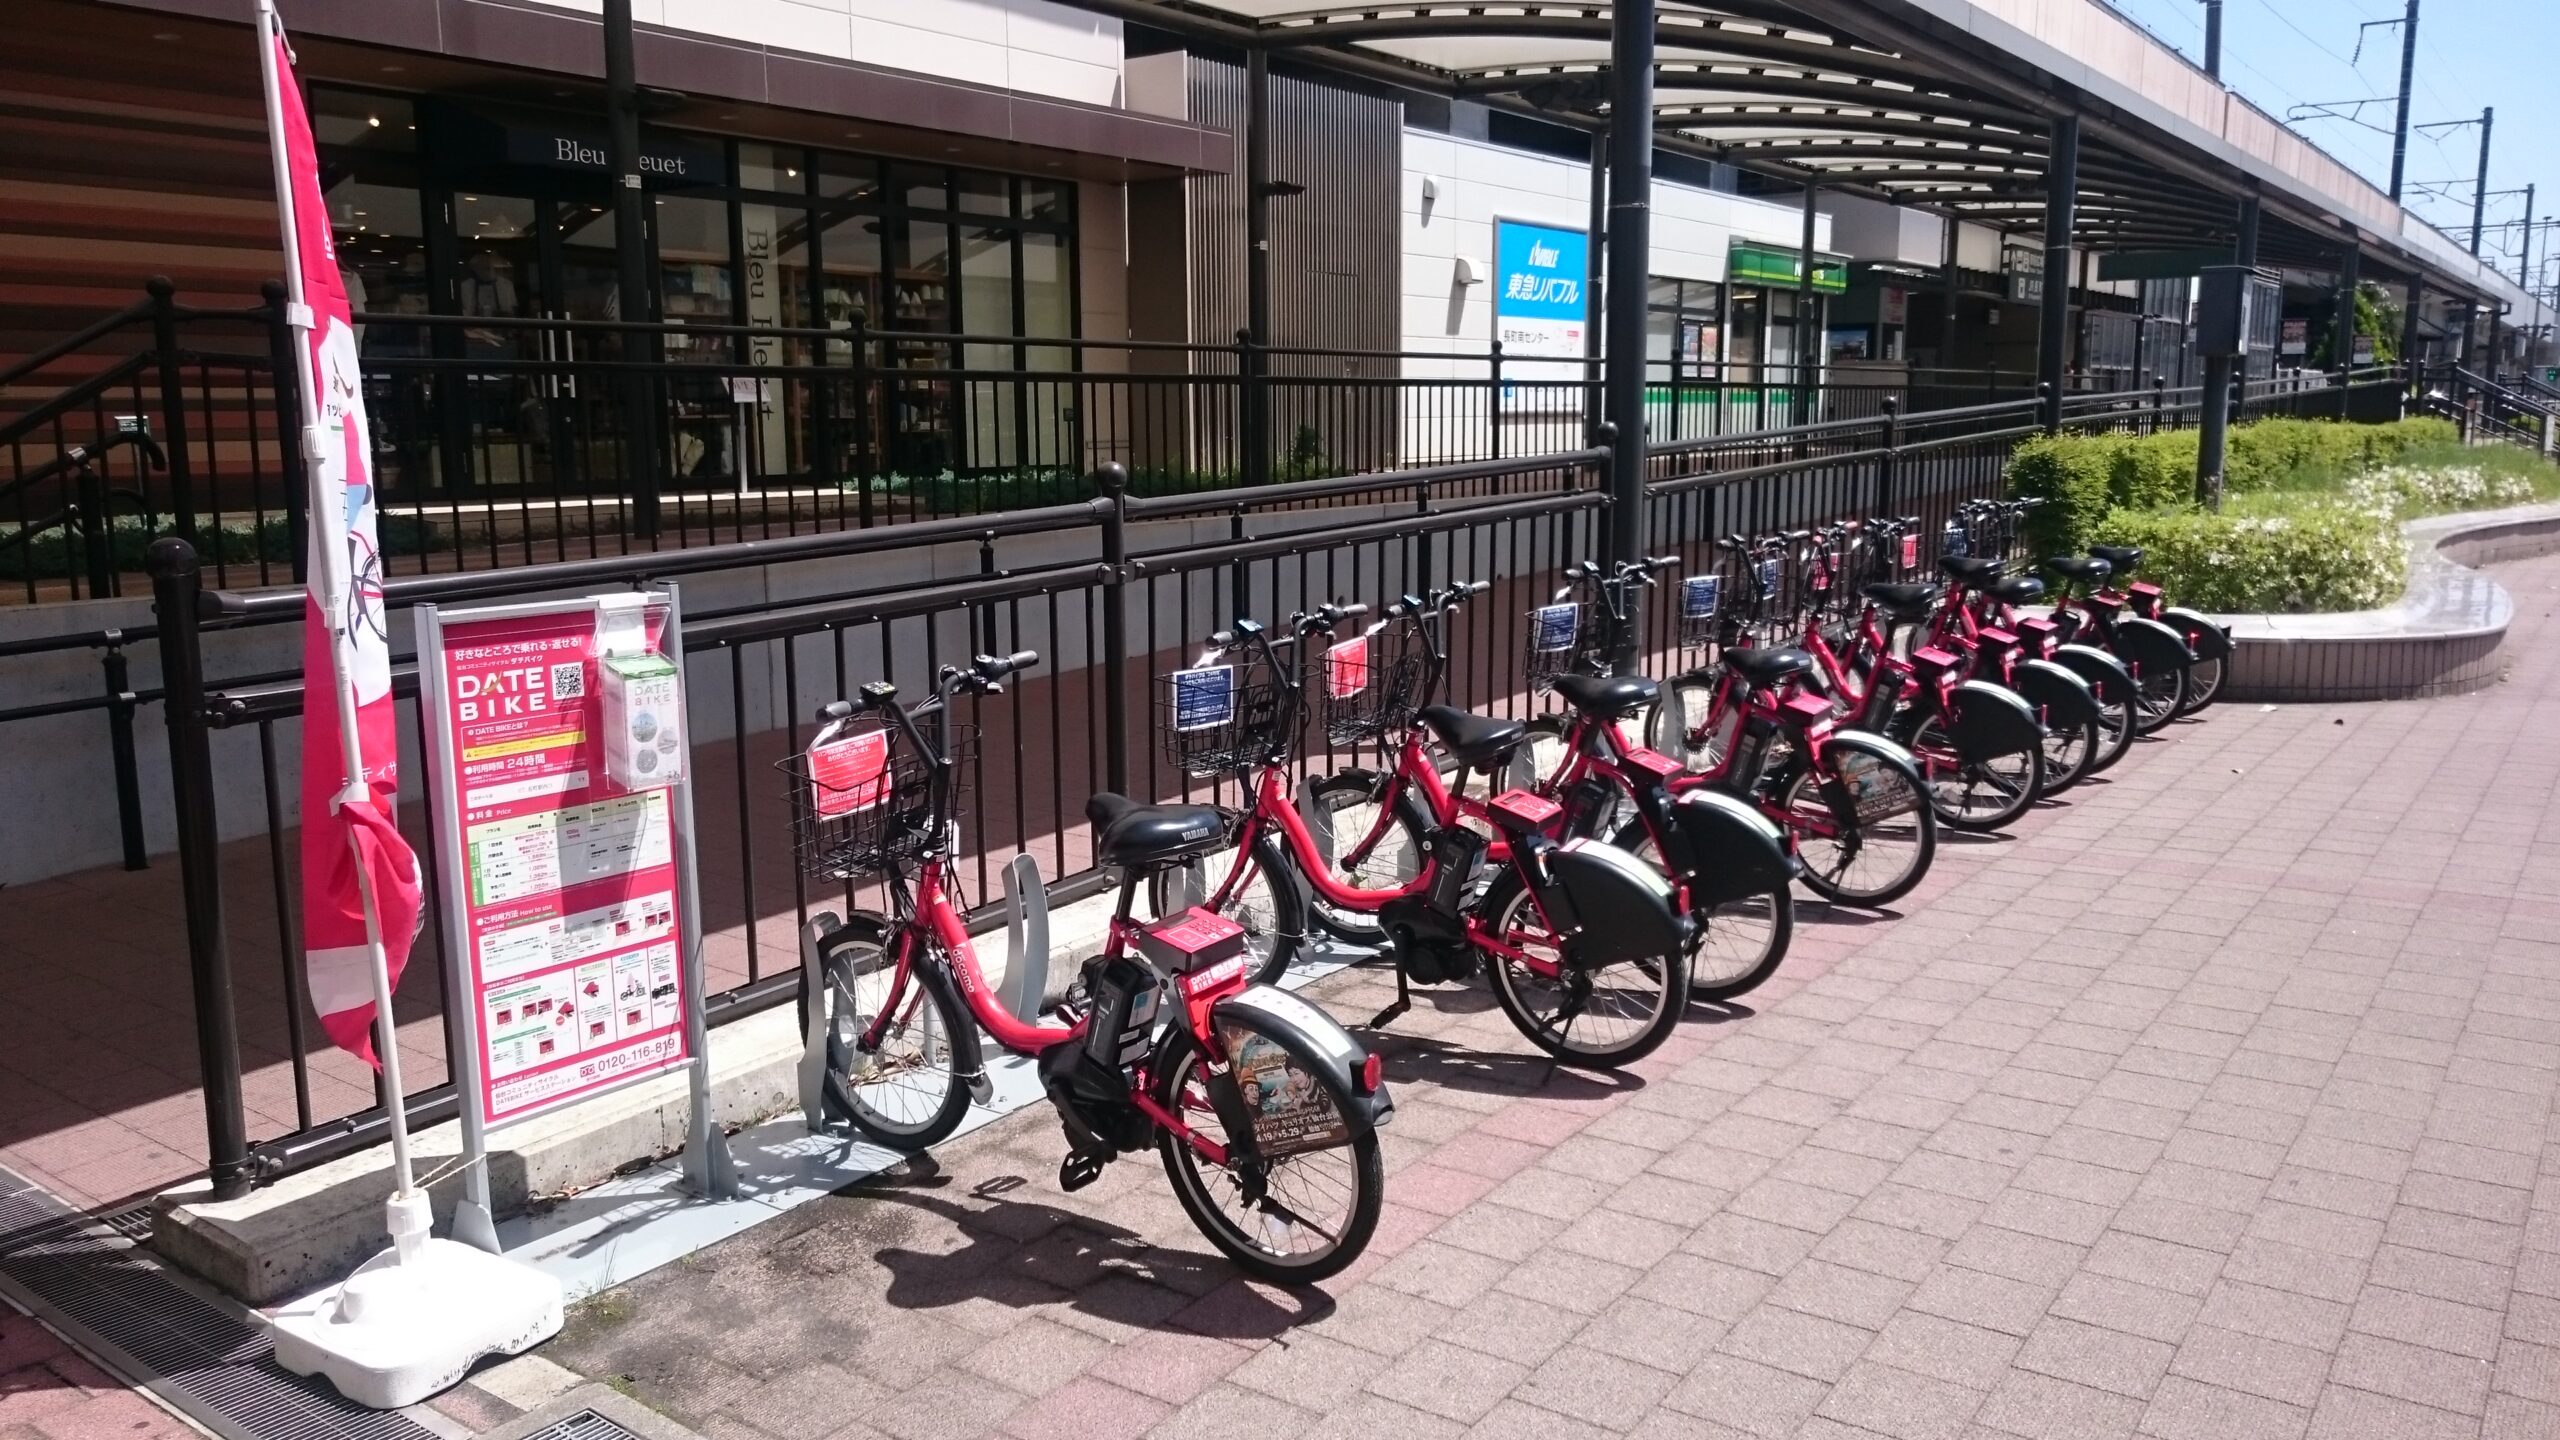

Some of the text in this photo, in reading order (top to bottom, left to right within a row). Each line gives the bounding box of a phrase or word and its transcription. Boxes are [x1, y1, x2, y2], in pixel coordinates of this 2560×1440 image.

[555, 138, 686, 175] Bleu euet
[747, 229, 768, 298] Bleu
[510, 655, 544, 665] ダテバイク
[457, 666, 545, 699] DATE
[459, 692, 547, 721] BIKE
[507, 753, 546, 769] 24時間
[476, 808, 513, 820] 料金 Price
[1181, 826, 1210, 842] YAMAHA
[520, 908, 534, 917] How
[541, 904, 553, 912] use
[952, 948, 975, 993] docomo
[598, 1038, 675, 1071] 0120-116-819
